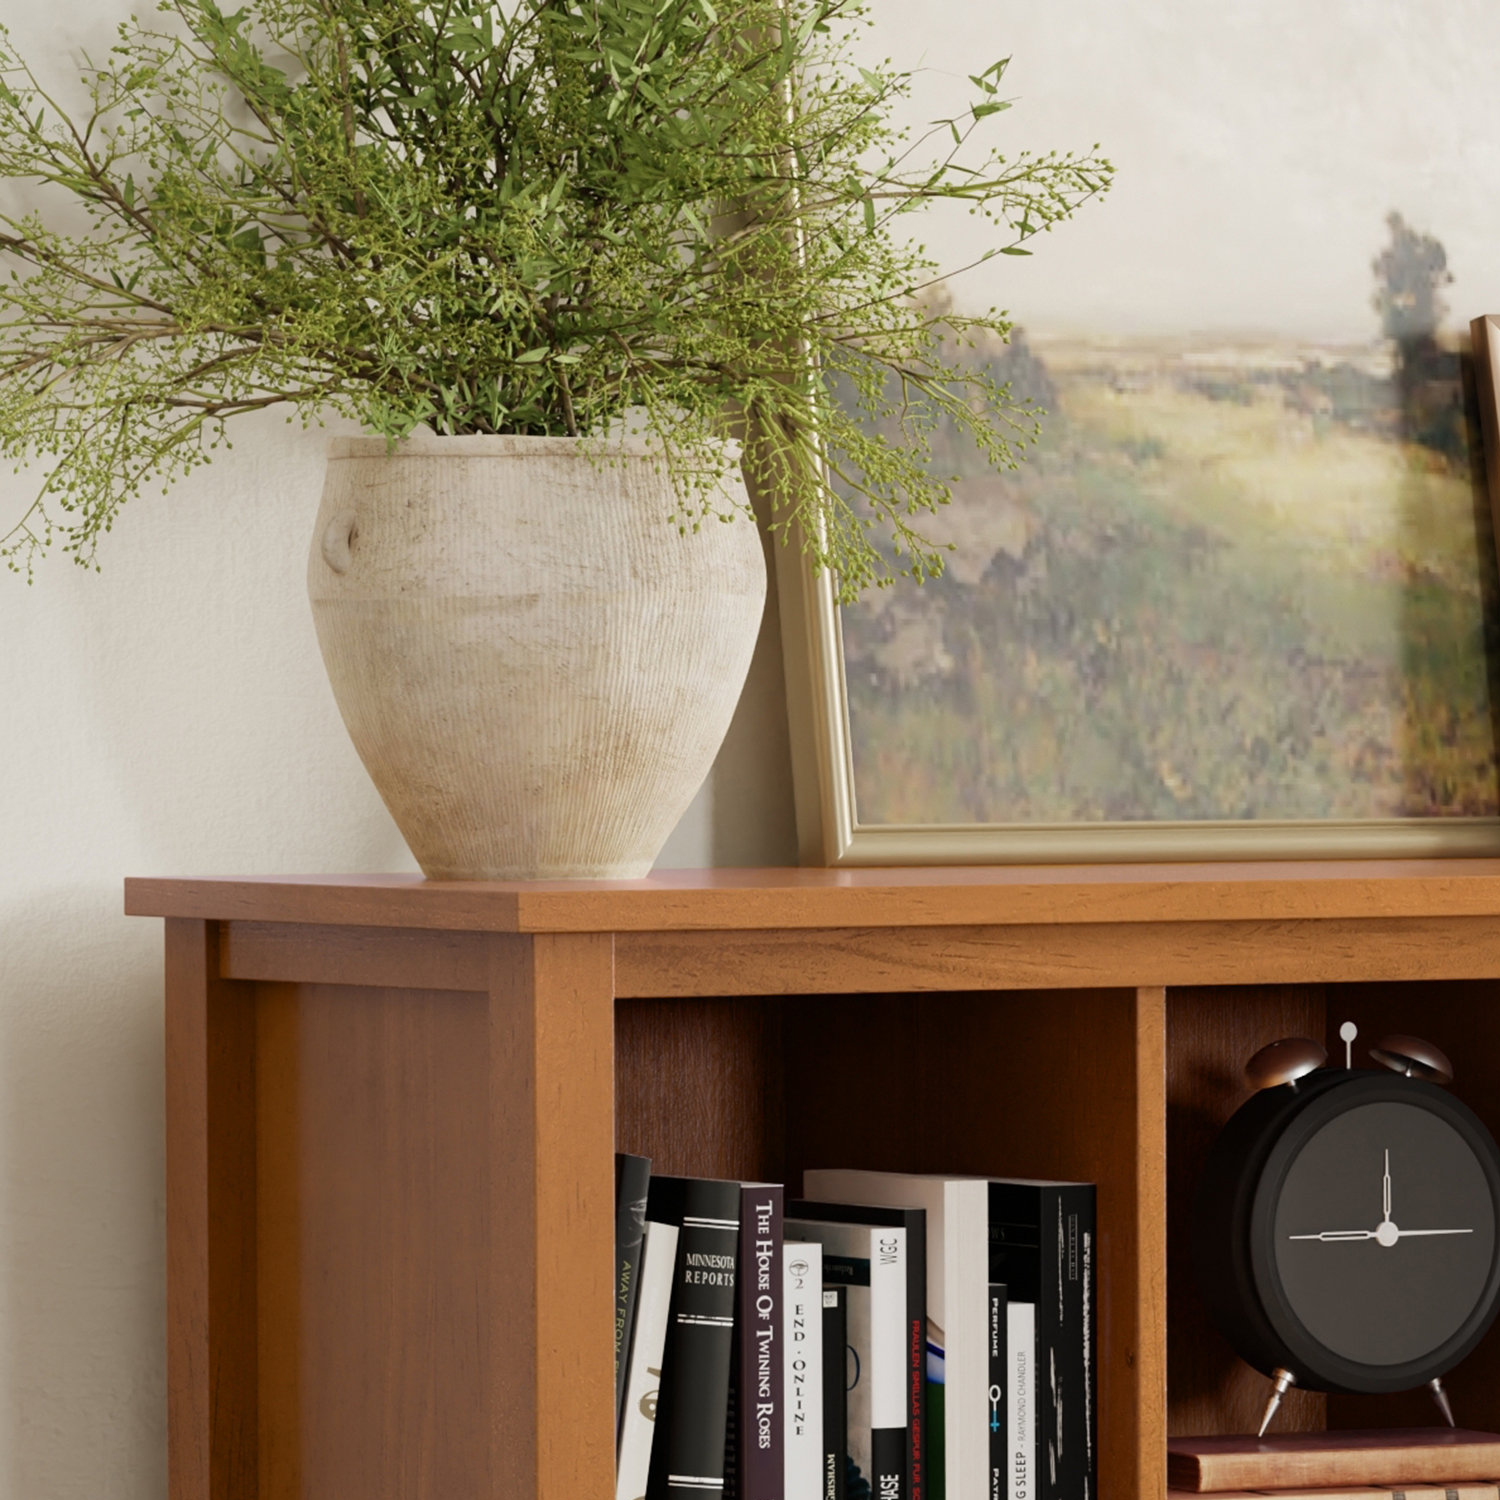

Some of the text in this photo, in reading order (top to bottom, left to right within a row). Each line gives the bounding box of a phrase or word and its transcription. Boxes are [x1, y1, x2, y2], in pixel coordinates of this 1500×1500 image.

[686, 1253, 734, 1270] MINNESOTA
[880, 1238, 897, 1265] WGC
[618, 1260, 631, 1304] AWAY
[685, 1270, 734, 1287] REPORTS
[756, 1200, 774, 1449] THE HOUSE OF TWINING ROSES
[1017, 1351, 1026, 1396] CHANDLER
[1017, 1399, 1026, 1442] RAYMOND
[1016, 1452, 1026, 1487] SLEEP
